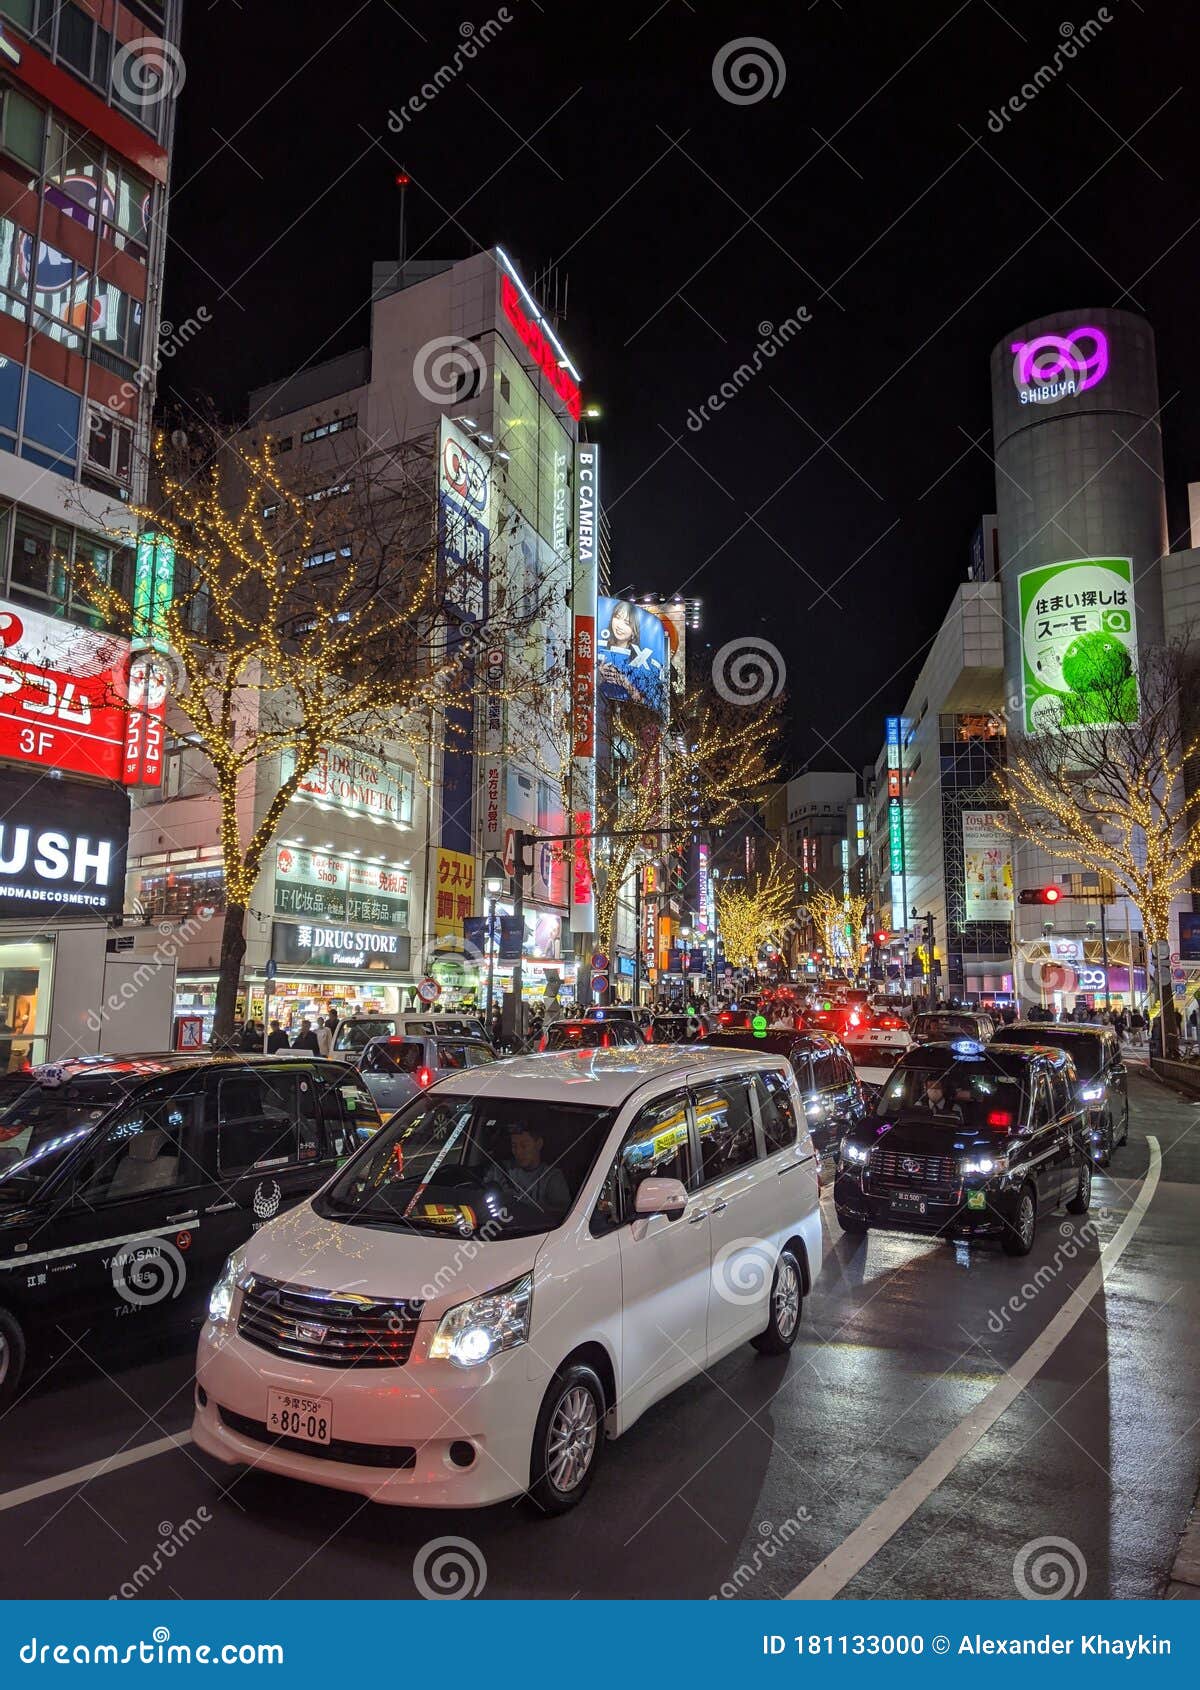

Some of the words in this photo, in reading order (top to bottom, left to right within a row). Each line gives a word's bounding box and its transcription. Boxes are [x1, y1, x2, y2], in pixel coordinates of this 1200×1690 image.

[1011, 328, 1109, 390] 109
[1020, 381, 1076, 404] SHIBUYA
[1036, 589, 1128, 615] 住まい探しは
[1037, 614, 1087, 640] スーモ
[20, 728, 55, 756] 3F
[127, 712, 141, 760] アコム
[145, 713, 161, 761] アコム
[127, 764, 137, 773] 3F
[146, 765, 157, 774] 3F
[329, 778, 396, 812] COSMETIC
[488, 768, 499, 833] 処方せん受付
[312, 852, 344, 872] Tax-Free
[439, 856, 473, 889] クスリ
[318, 868, 338, 885] Shop
[378, 870, 408, 895] 免税店
[298, 925, 313, 947] 薬
[314, 927, 355, 950] DRUG
[355, 932, 398, 953] STORE
[102, 1246, 161, 1269] YAMASAN
[113, 1301, 142, 1318] TAXI
[301, 1399, 318, 1414] 558
[281, 1410, 327, 1440] 80-08
